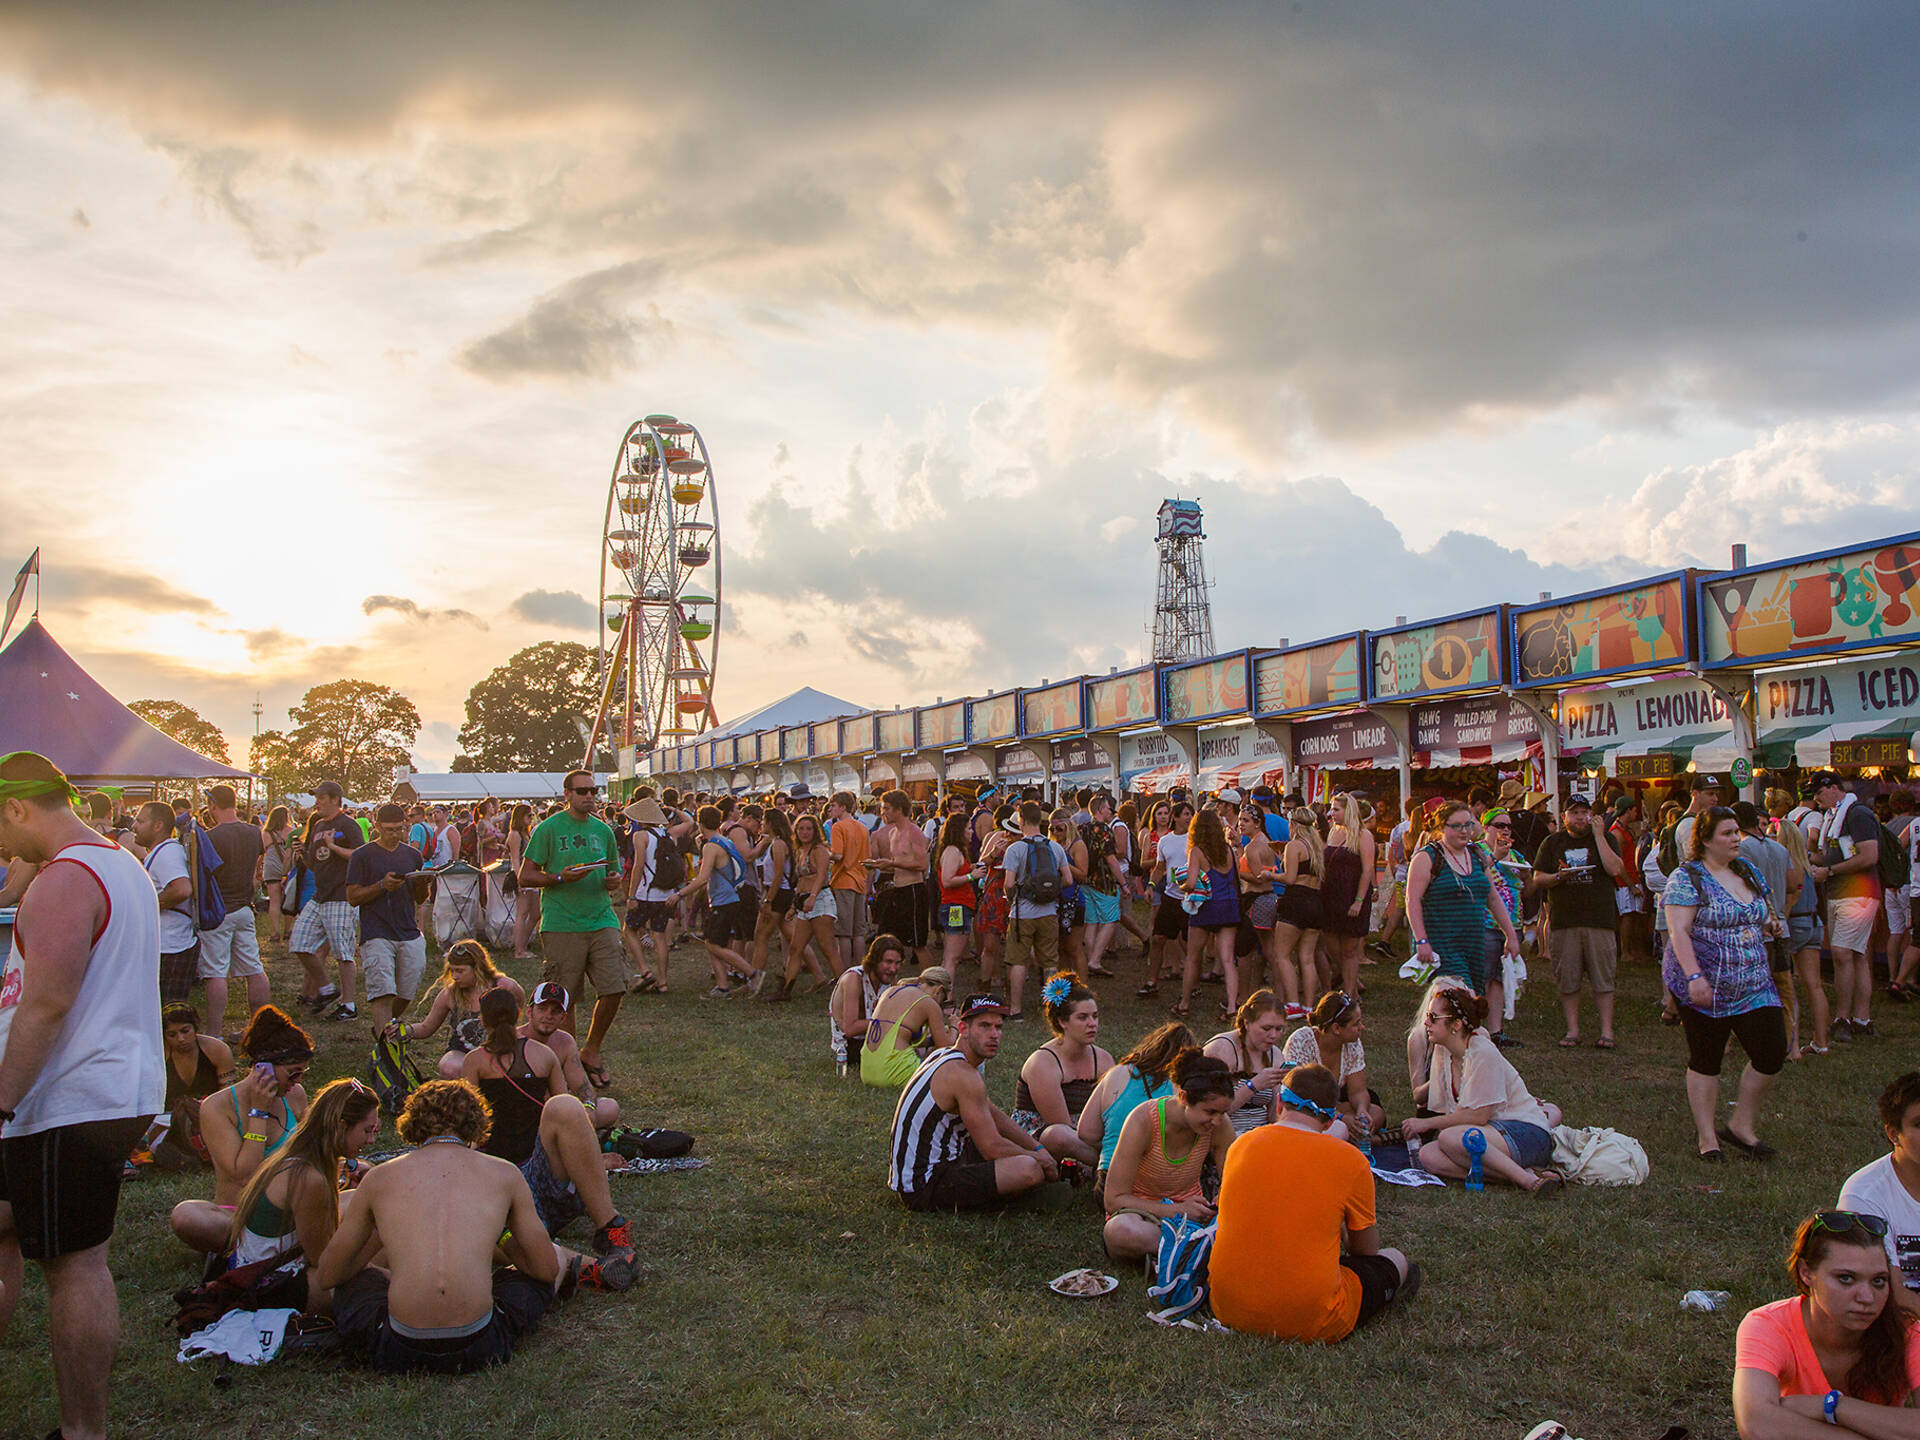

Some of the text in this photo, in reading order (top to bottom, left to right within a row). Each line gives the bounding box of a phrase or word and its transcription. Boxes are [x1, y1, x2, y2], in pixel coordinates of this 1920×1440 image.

[1418, 710, 1440, 726] HAWG
[1453, 709, 1498, 727] PULLED PORK
[1636, 690, 1731, 731] LEMONAD
[1418, 729, 1440, 744] DAWG
[1457, 727, 1492, 744] SANDWICH
[1201, 736, 1240, 760] BREAKFAST
[1253, 741, 1280, 757] LEMONAD
[1300, 736, 1319, 756] CORN
[1320, 735, 1339, 753] DOGS
[1881, 744, 1901, 761] PIE
[1618, 758, 1670, 775] SPIY PIE
